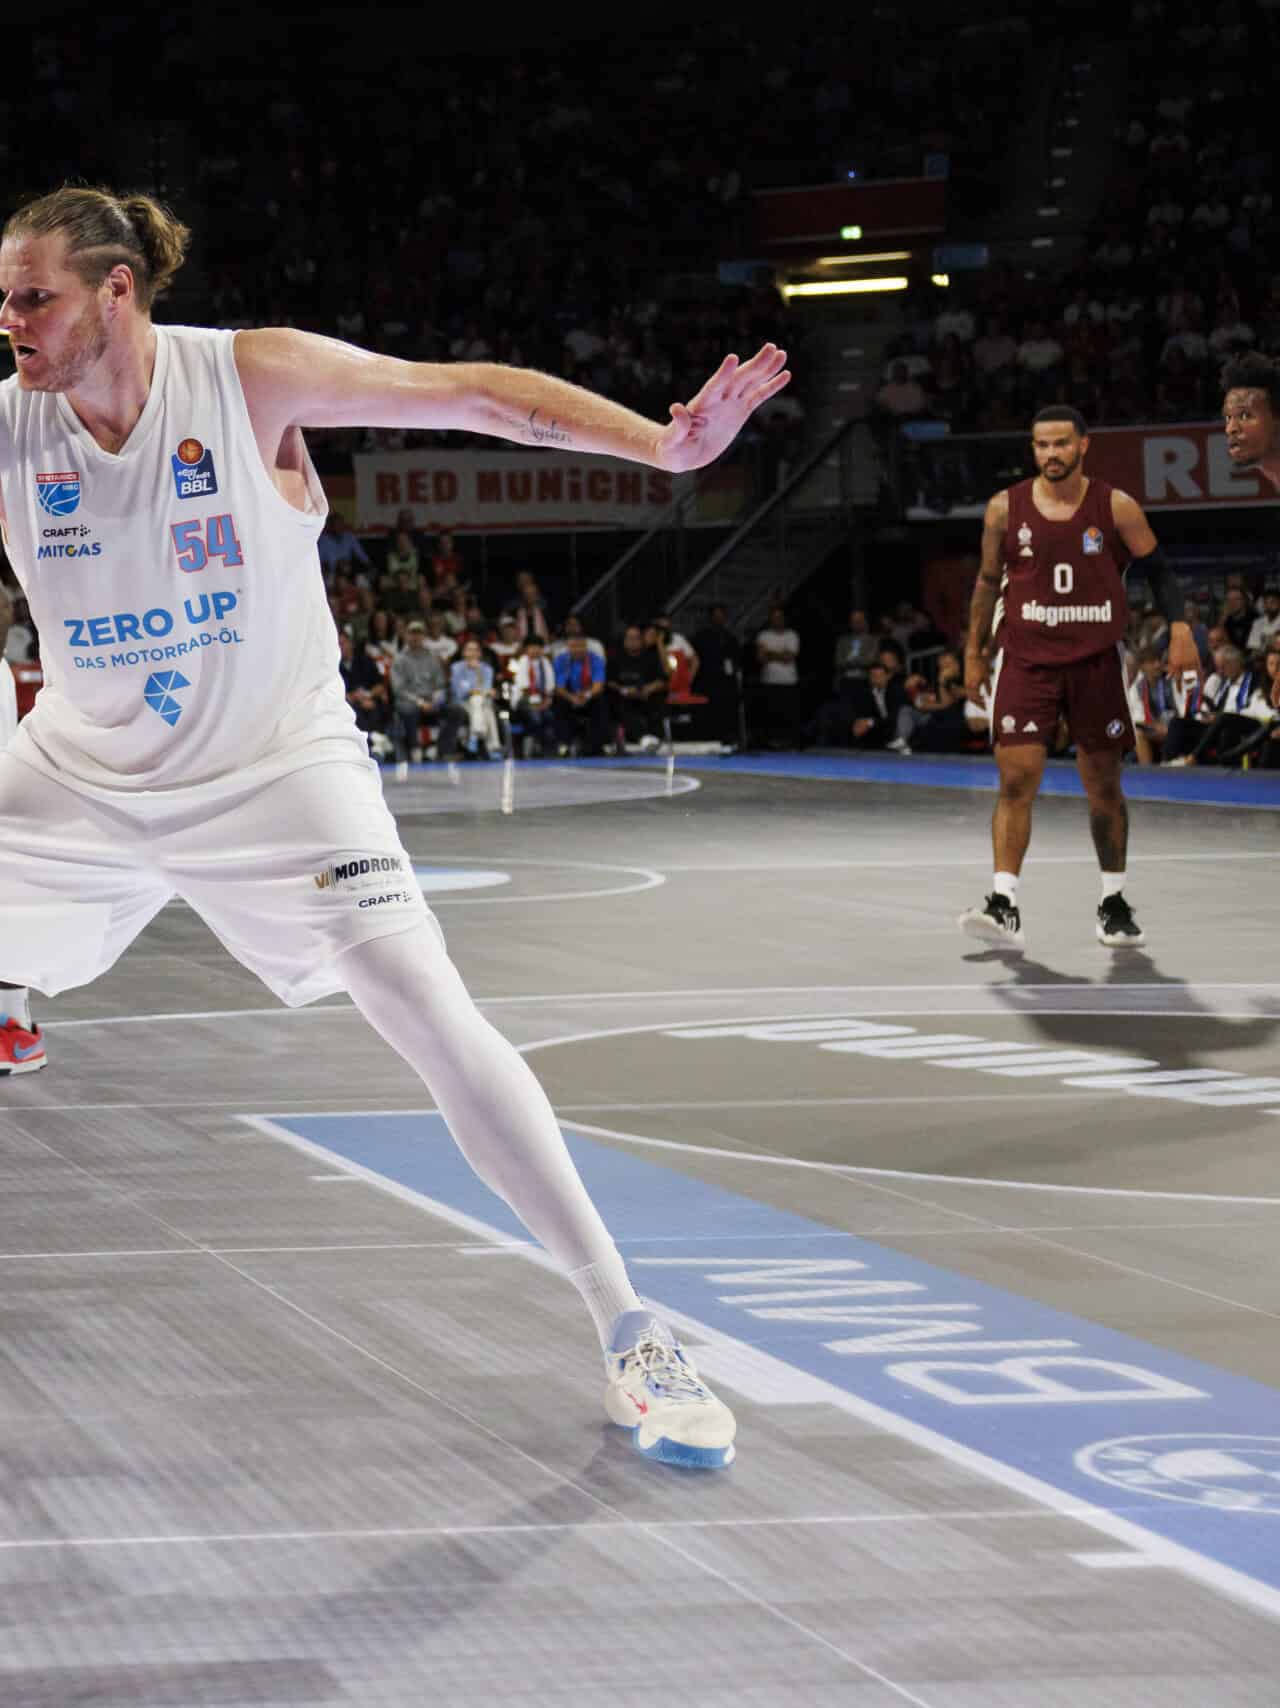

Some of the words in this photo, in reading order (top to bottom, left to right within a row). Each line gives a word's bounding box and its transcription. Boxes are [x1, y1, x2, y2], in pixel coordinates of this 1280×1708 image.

[1143, 437, 1260, 500] RE
[180, 479, 213, 496] BBL
[376, 471, 458, 506] RED
[42, 527, 80, 538] CRAFT
[170, 513, 244, 573] 54
[37, 542, 103, 560] MITGAS
[1053, 563, 1074, 594] 0
[63, 608, 174, 648] ZERO
[184, 591, 238, 625] UP
[1021, 599, 1113, 627] siegmund
[73, 656, 107, 670] DAS
[111, 627, 246, 668] MOTORRAD-ÖL
[358, 894, 401, 908] CRAFT
[630, 1257, 1213, 1405] BMW
